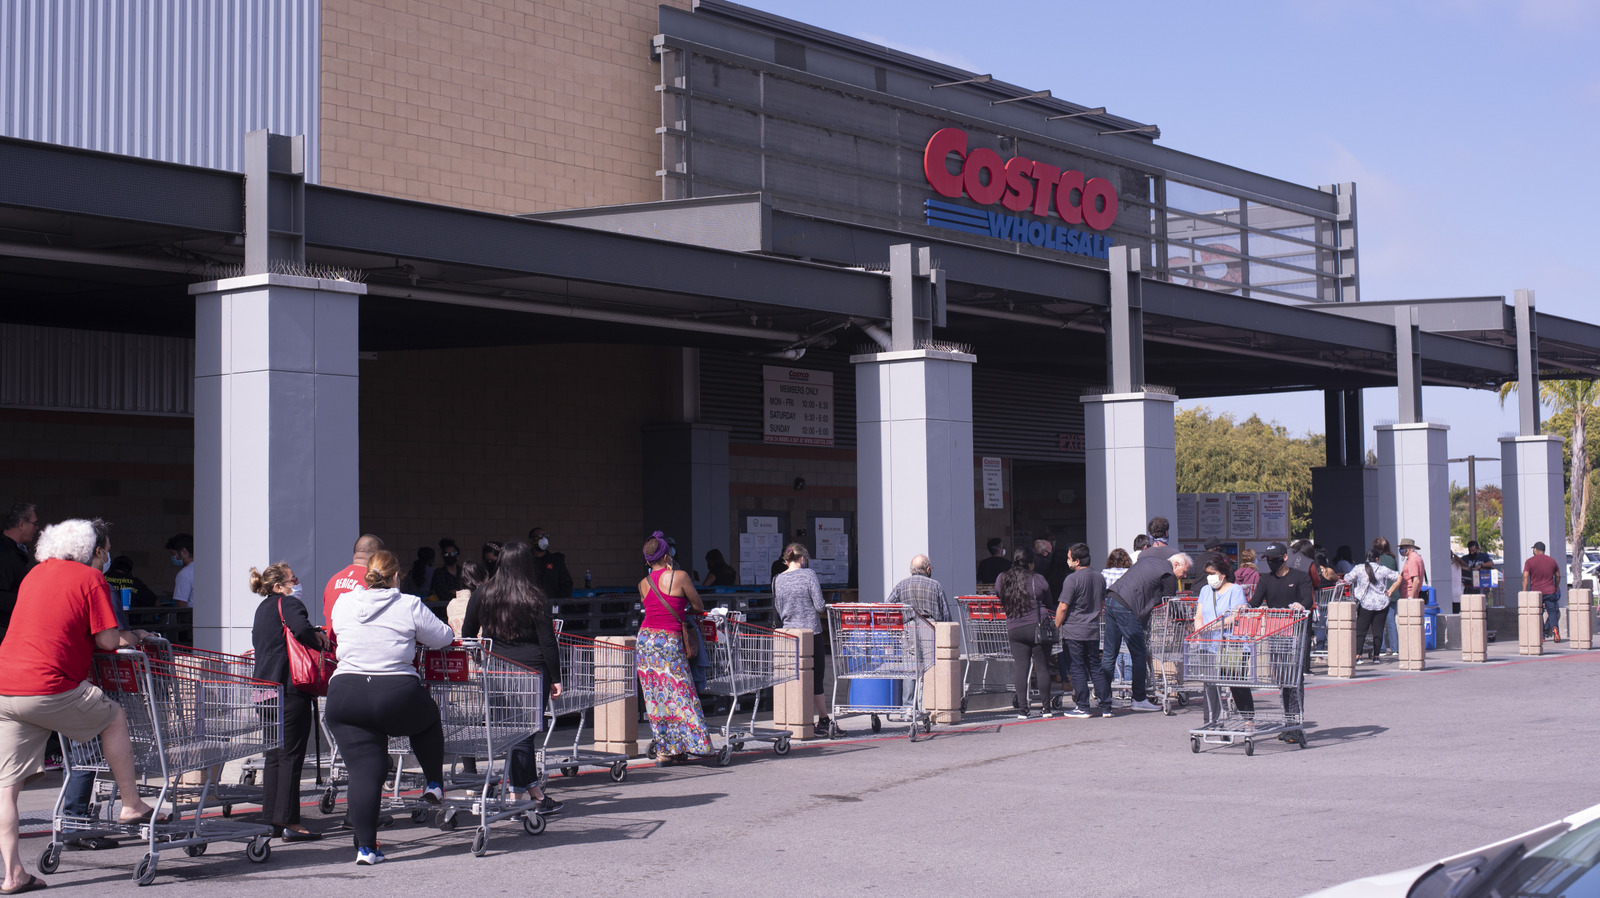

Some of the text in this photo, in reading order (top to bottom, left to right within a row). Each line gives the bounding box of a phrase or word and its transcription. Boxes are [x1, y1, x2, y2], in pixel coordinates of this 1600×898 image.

[924, 127, 1118, 231] COSTCO
[789, 370, 809, 378] COSTCO
[780, 384, 819, 396] MEMBERS ONLY
[769, 397, 782, 406] MON
[786, 398, 794, 407] FRI
[769, 410, 796, 420] SATURDAY
[769, 424, 790, 433] SUNDAY
[1059, 433, 1085, 453] EXIT
[334, 578, 358, 590] REDICK
